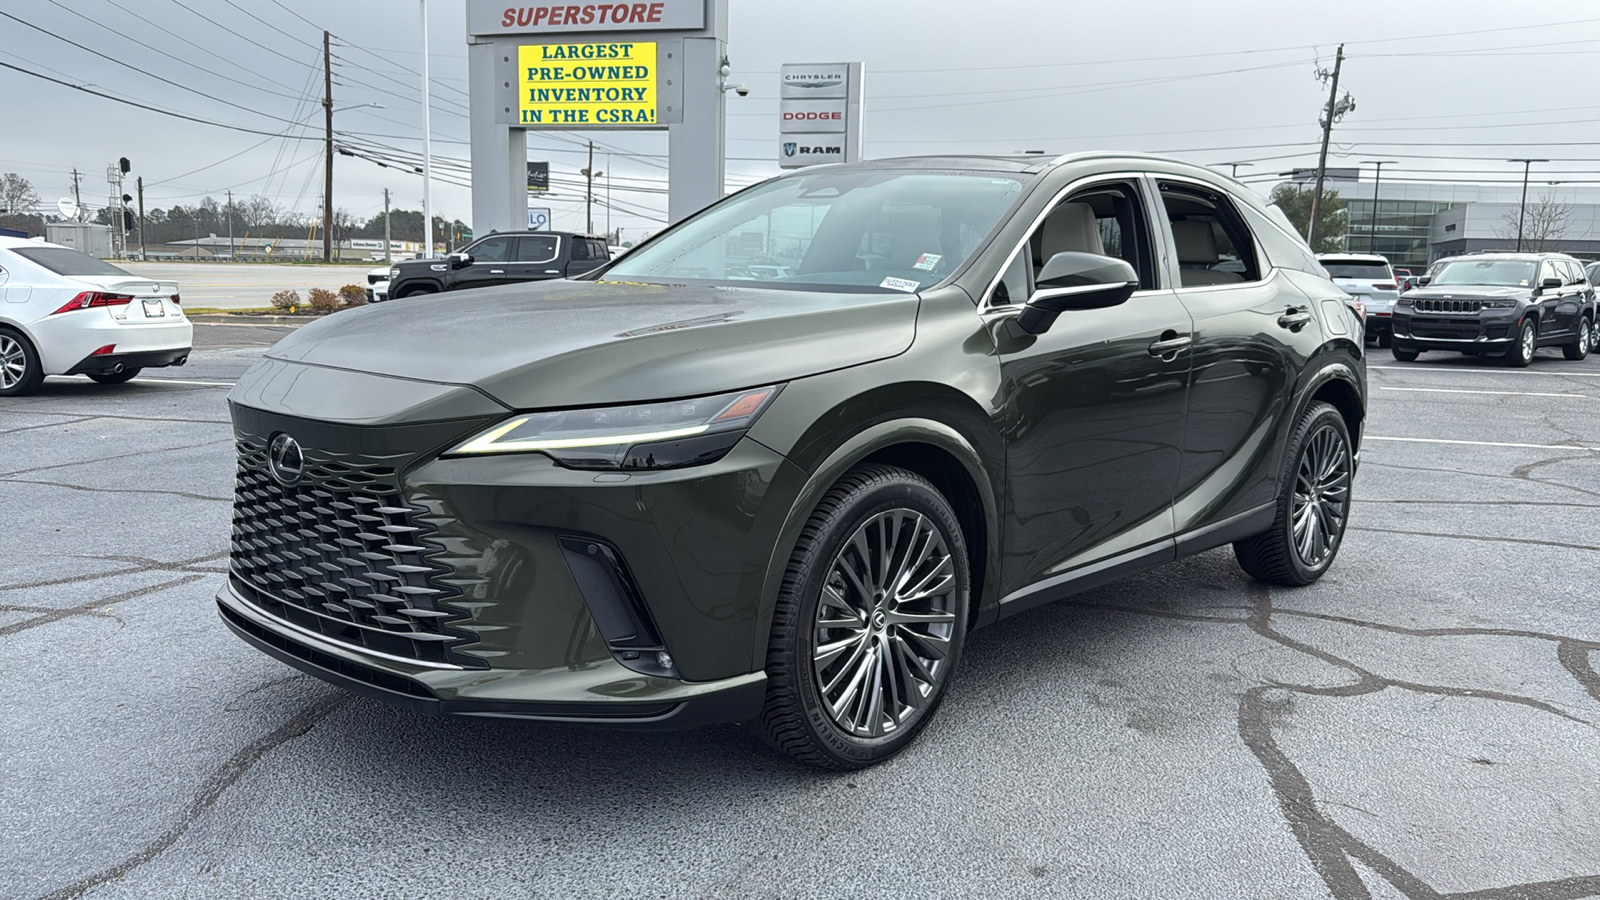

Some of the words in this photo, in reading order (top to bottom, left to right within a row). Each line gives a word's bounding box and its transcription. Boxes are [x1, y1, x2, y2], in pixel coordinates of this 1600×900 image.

[501, 3, 665, 28] SUPERSTORE
[541, 44, 633, 60] LARGEST
[527, 66, 649, 81] PRE-OWNED
[529, 87, 648, 102] INVENTORY
[522, 110, 542, 122] IN
[549, 109, 589, 122] THE
[596, 109, 656, 122] CSRA!
[783, 111, 842, 120] DODGE
[799, 146, 841, 154] RAM
[812, 713, 858, 757] MICHELIN
